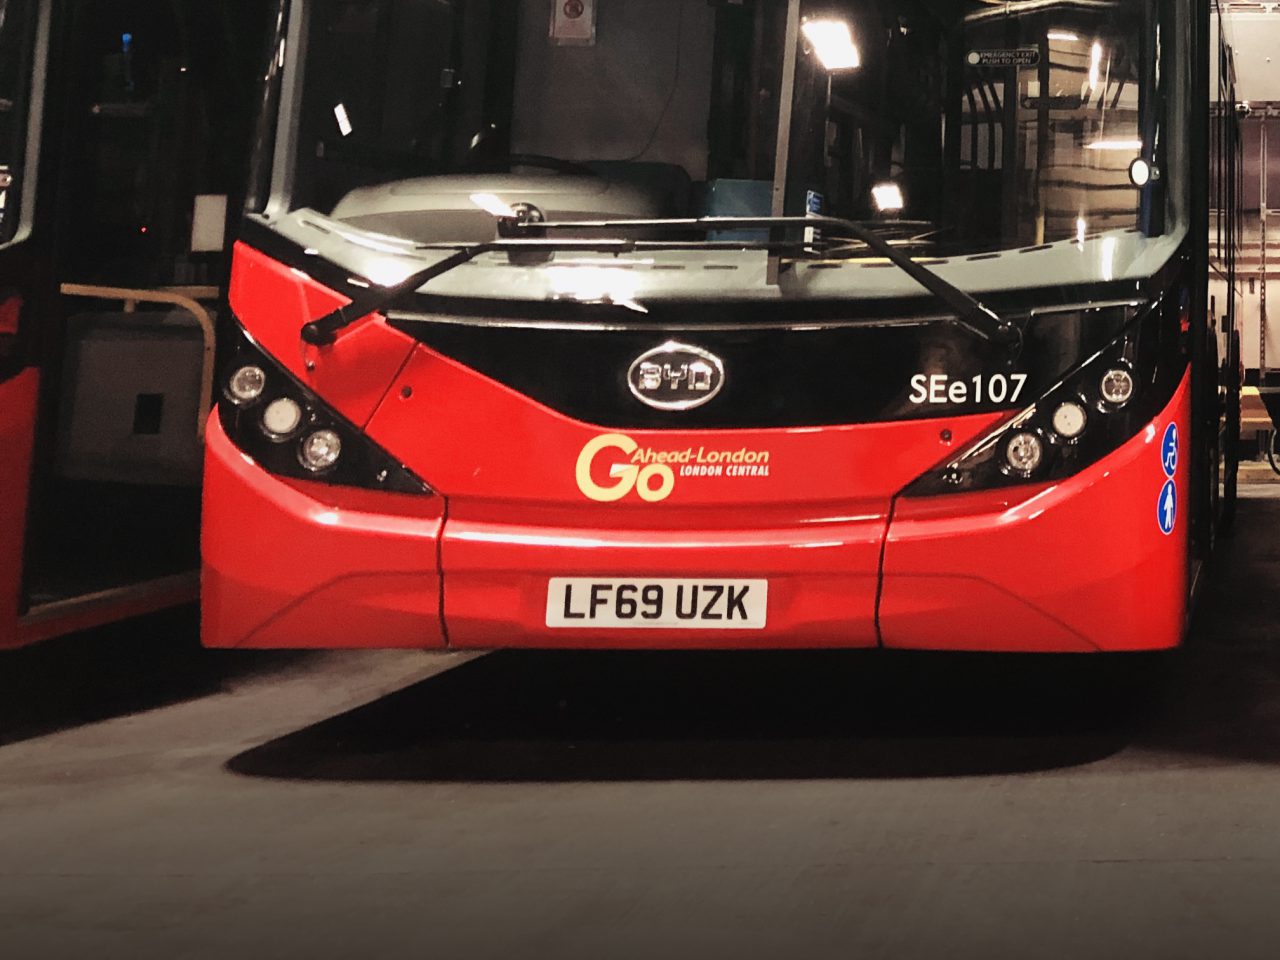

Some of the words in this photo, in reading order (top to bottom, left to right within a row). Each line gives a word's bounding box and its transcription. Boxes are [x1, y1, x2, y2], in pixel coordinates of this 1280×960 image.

[639, 362, 713, 391] BYD
[908, 373, 1028, 405] SEe107
[576, 433, 675, 502] Go
[630, 446, 770, 464] Ahead-London
[680, 464, 722, 477] LONDON
[726, 464, 769, 477] CENTRAL
[563, 584, 664, 619] LF69
[676, 584, 750, 620] UZK
